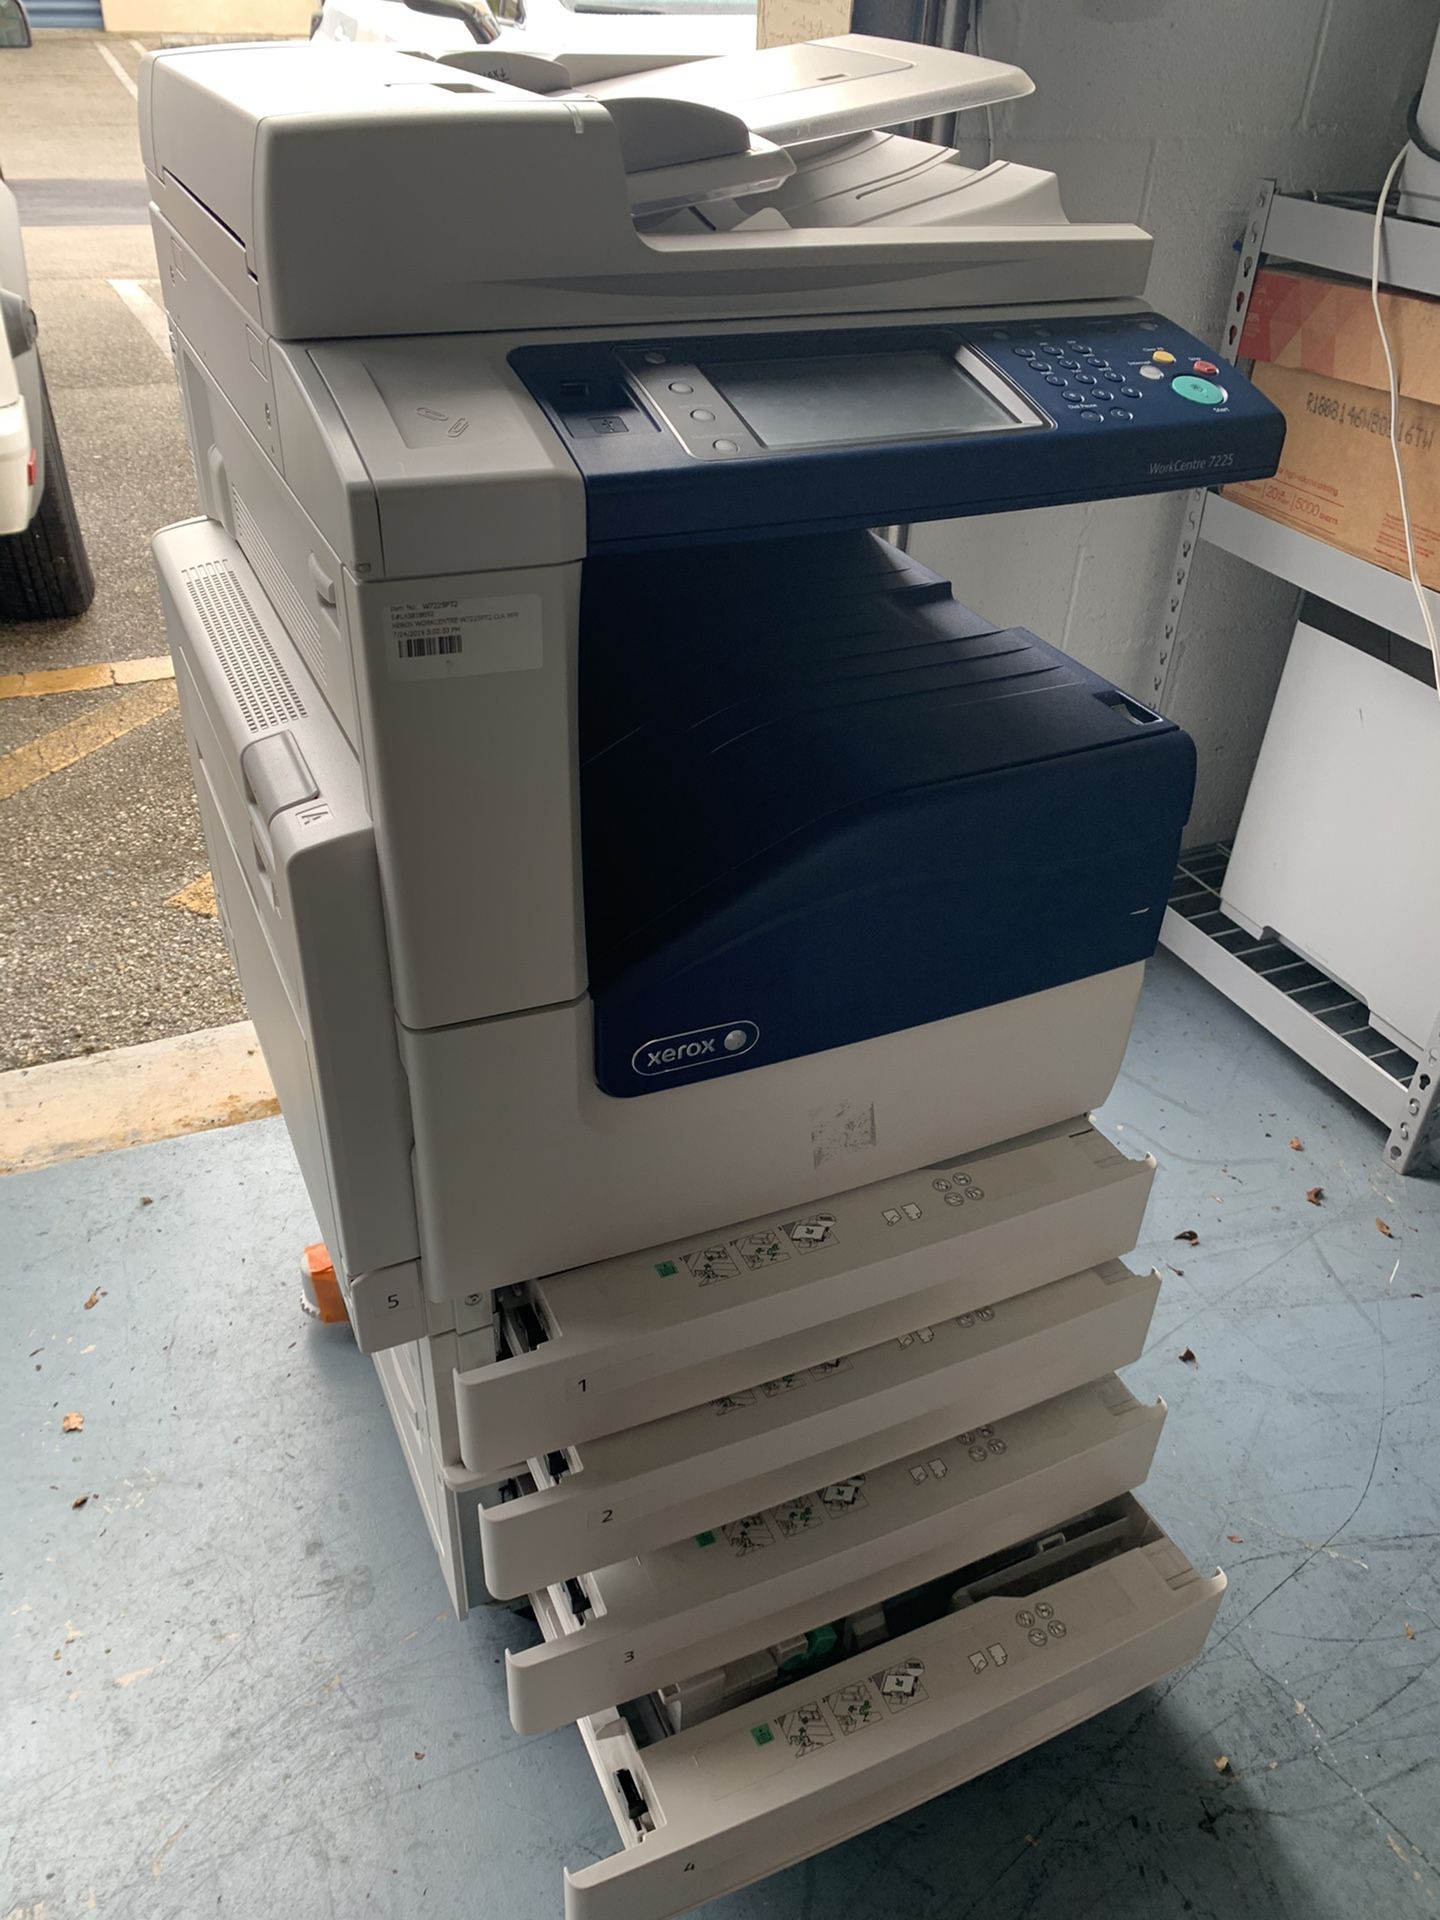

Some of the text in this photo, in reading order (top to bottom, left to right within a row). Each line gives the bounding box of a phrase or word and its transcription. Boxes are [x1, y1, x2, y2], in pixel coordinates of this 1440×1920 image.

[1149, 453, 1235, 475] WorkCentre 7225
[1294, 497, 1320, 517] 5000
[647, 1038, 716, 1067] xerox
[387, 1294, 400, 1309] 5
[577, 1379, 587, 1392] 1
[602, 1509, 613, 1524] 2
[624, 1650, 635, 1664] 3
[683, 1861, 695, 1872] 4
